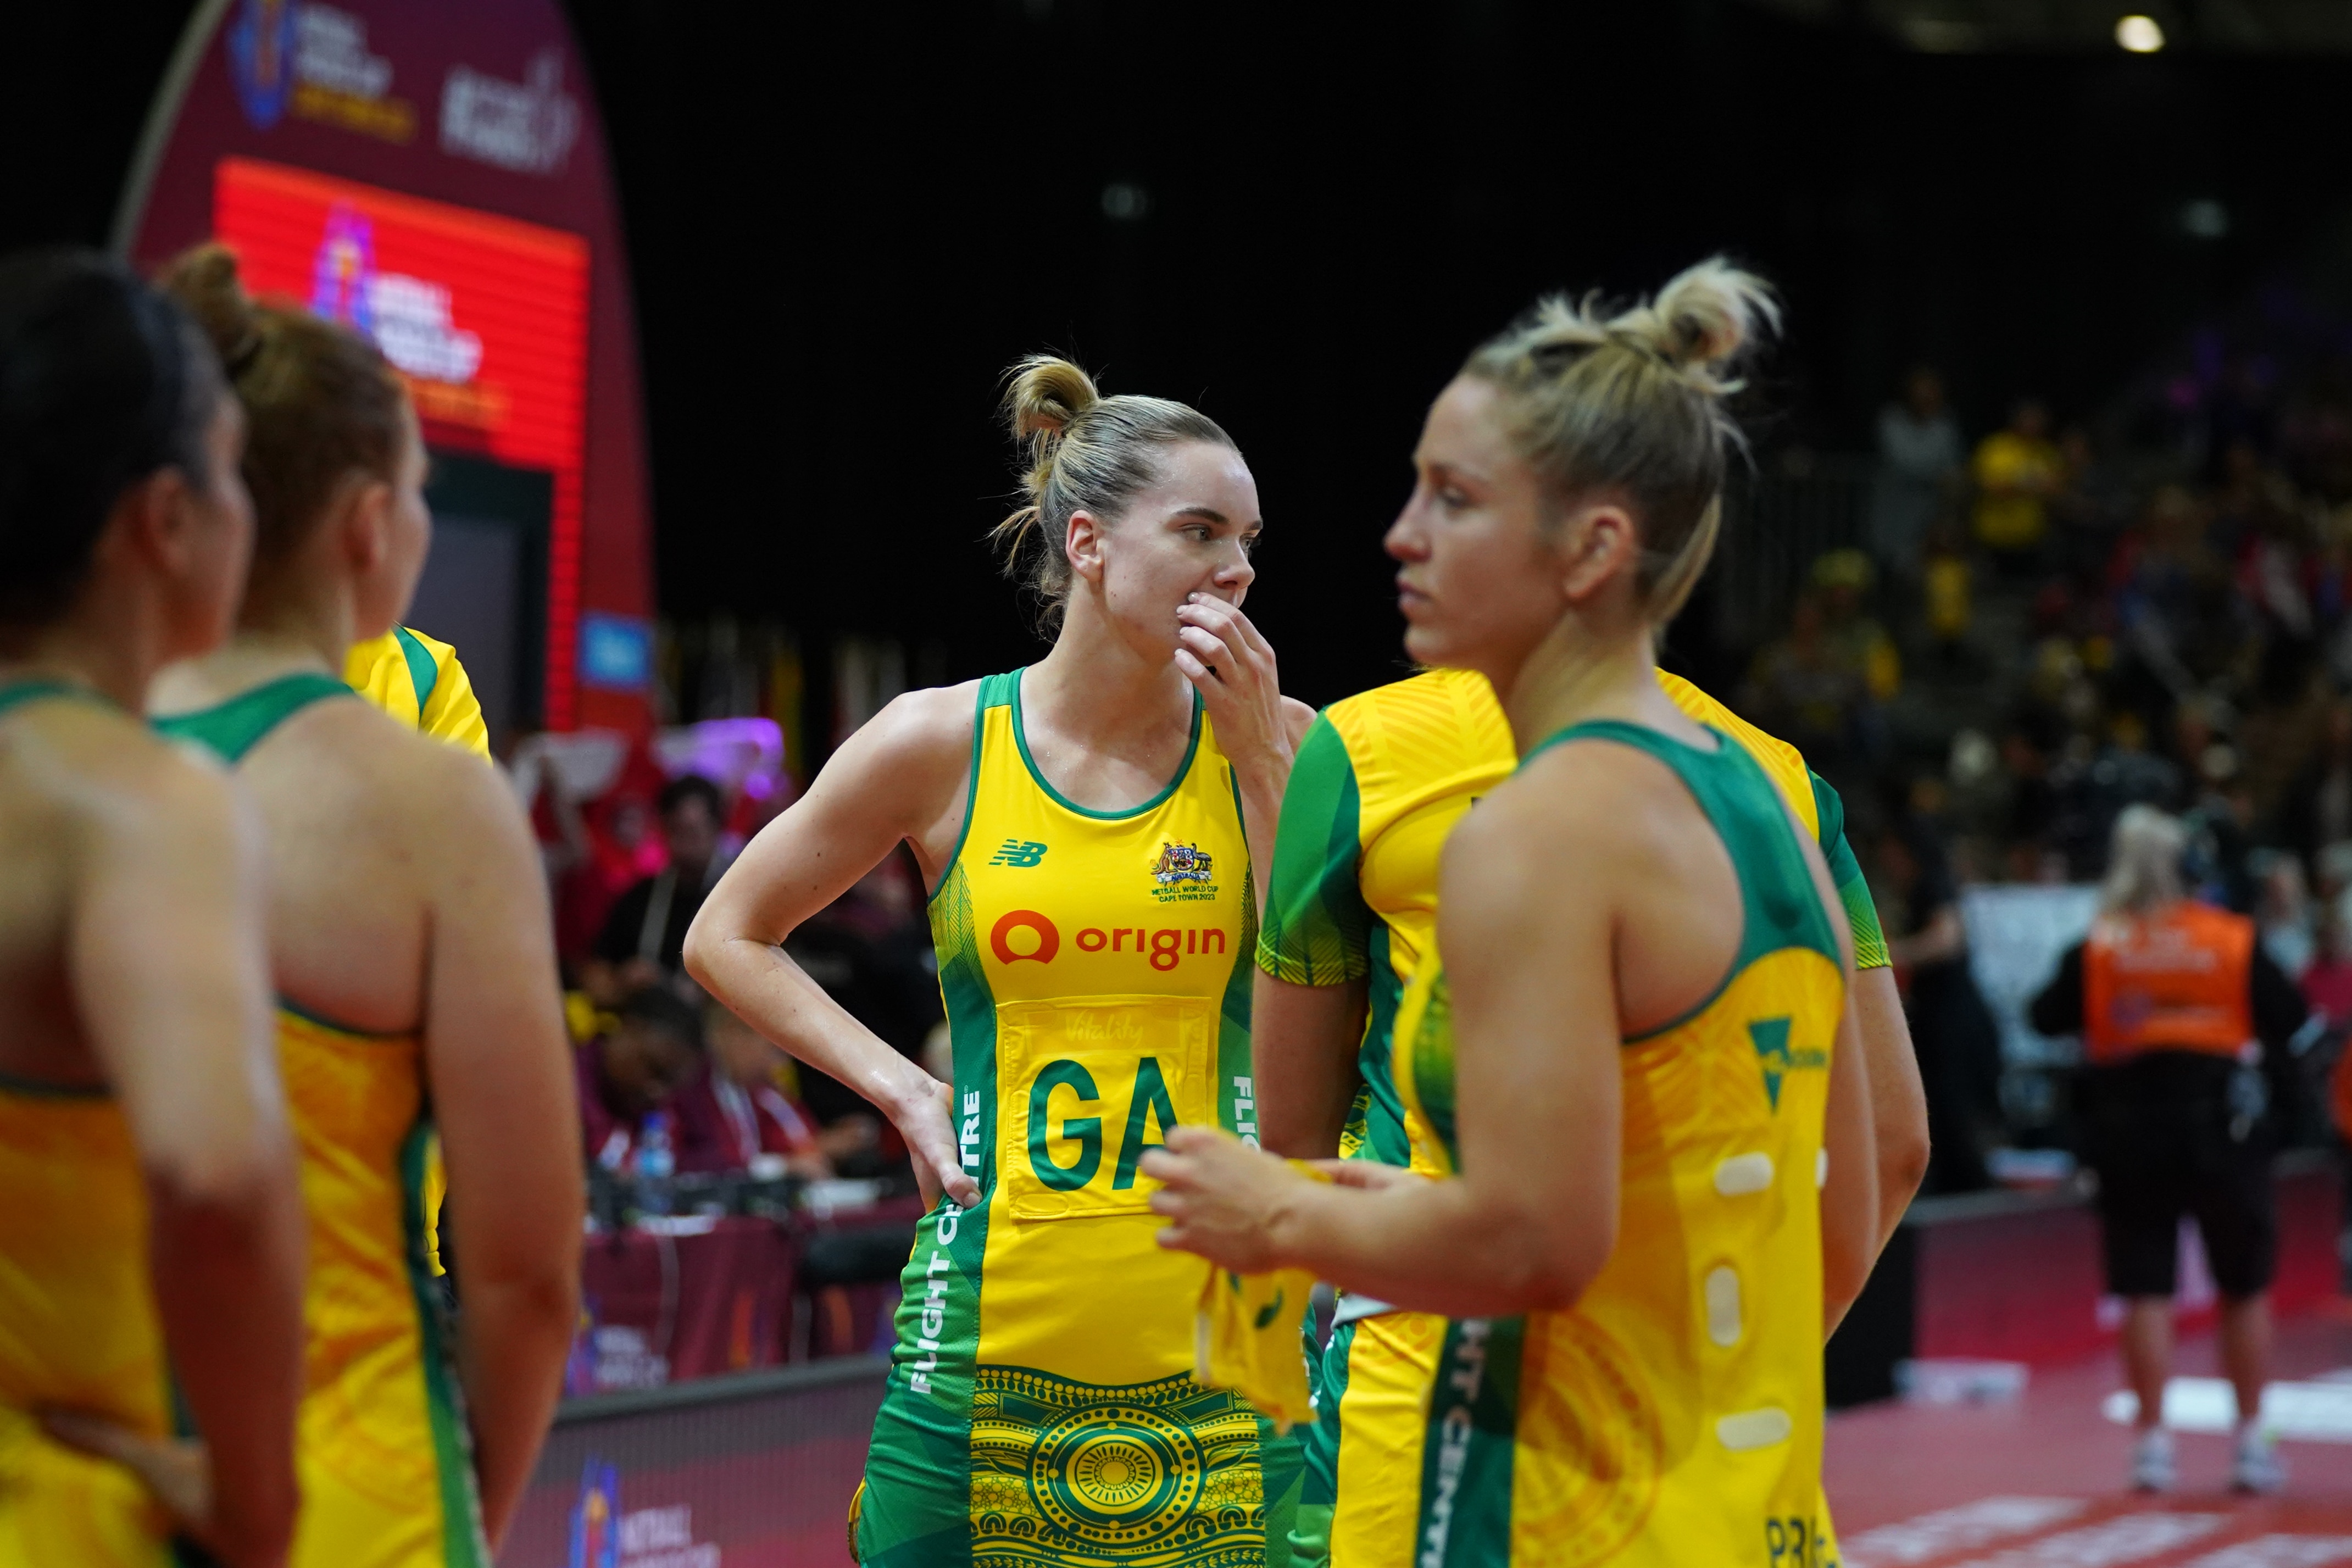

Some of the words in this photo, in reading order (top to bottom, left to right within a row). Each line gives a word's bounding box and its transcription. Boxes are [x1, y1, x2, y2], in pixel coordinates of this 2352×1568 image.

[1152, 887, 1181, 896] NETBALL
[1076, 927, 1225, 971] origin
[1065, 1009, 1143, 1049] Vitality
[1028, 1057, 1179, 1192] GA
[910, 1250, 950, 1394] FLIGHT
[937, 1091, 980, 1246] CETRE
